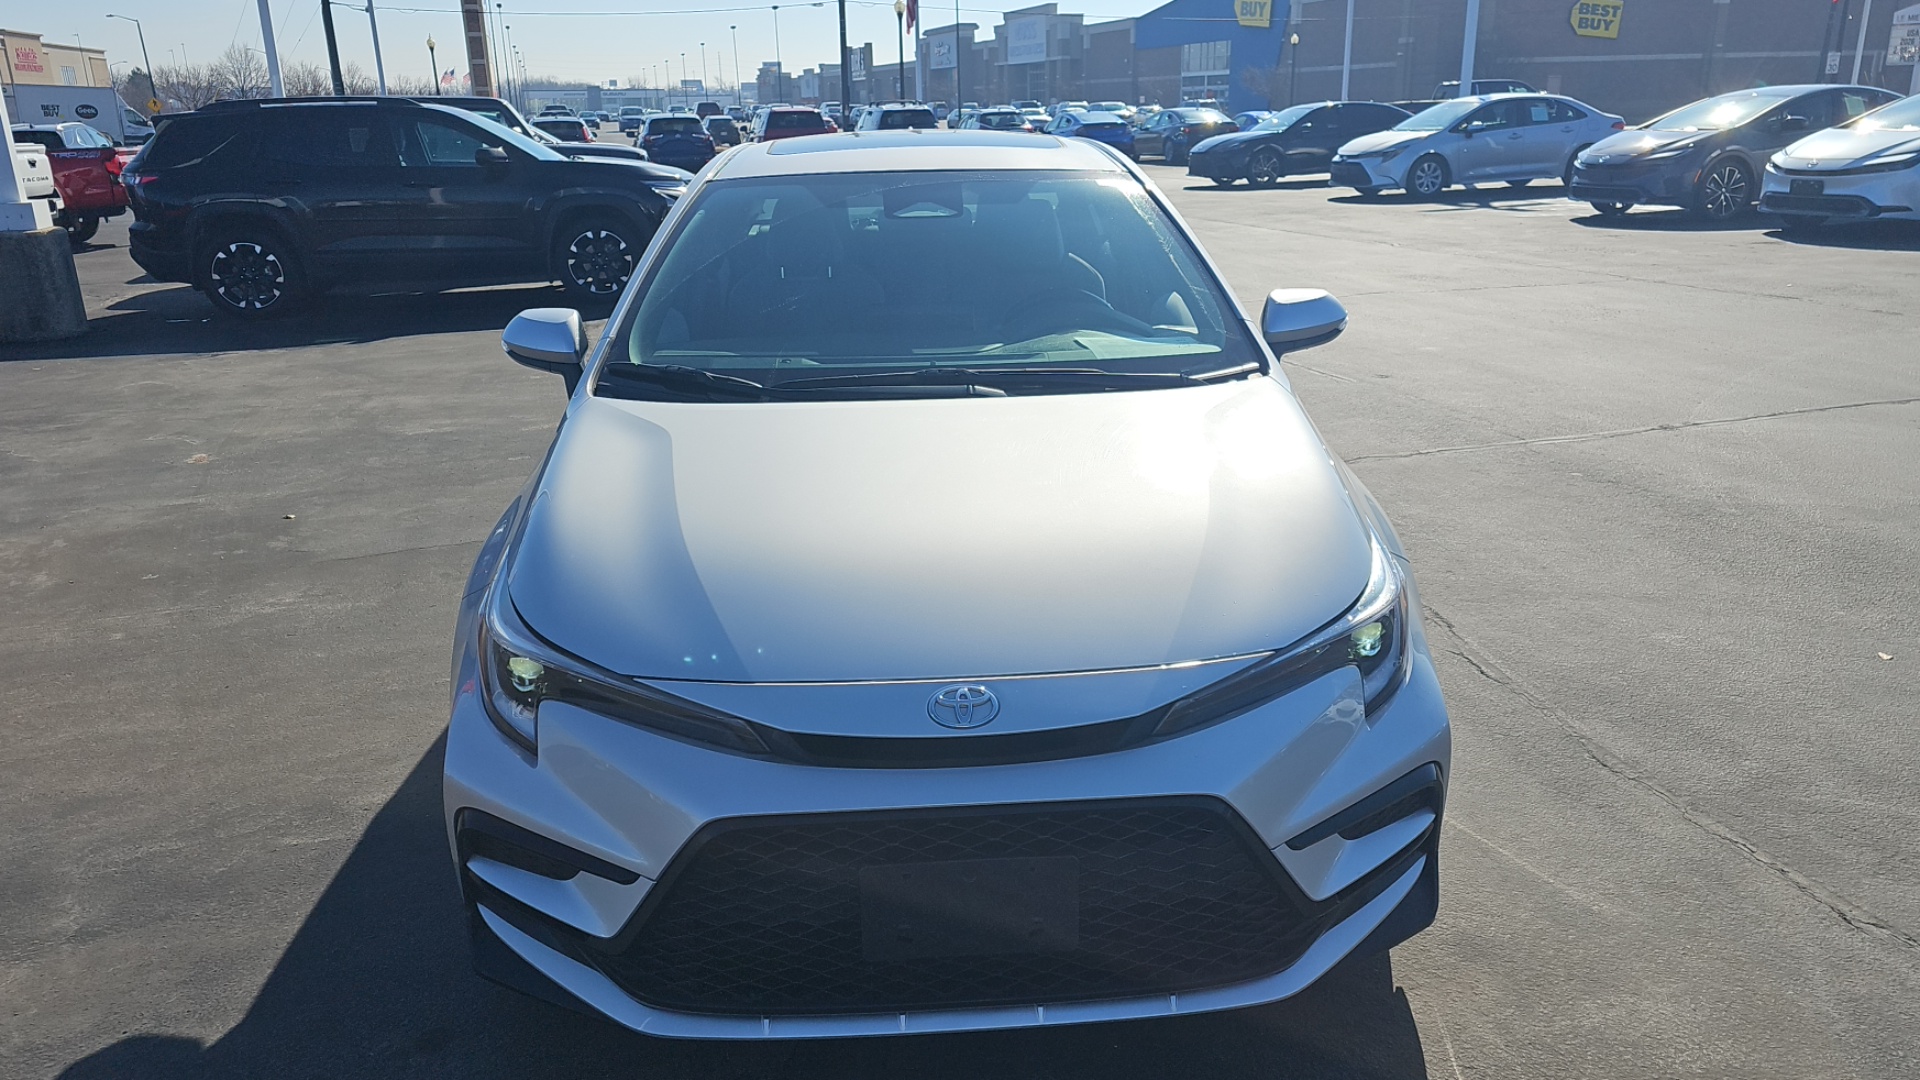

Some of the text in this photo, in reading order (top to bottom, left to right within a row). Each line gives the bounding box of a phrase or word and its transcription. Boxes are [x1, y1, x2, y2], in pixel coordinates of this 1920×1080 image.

[1240, 1, 1268, 17] BUY
[1578, 2, 1622, 18] BEST
[1577, 17, 1615, 31] BUY
[1827, 63, 1838, 72] 30
[77, 106, 97, 114] Geek
